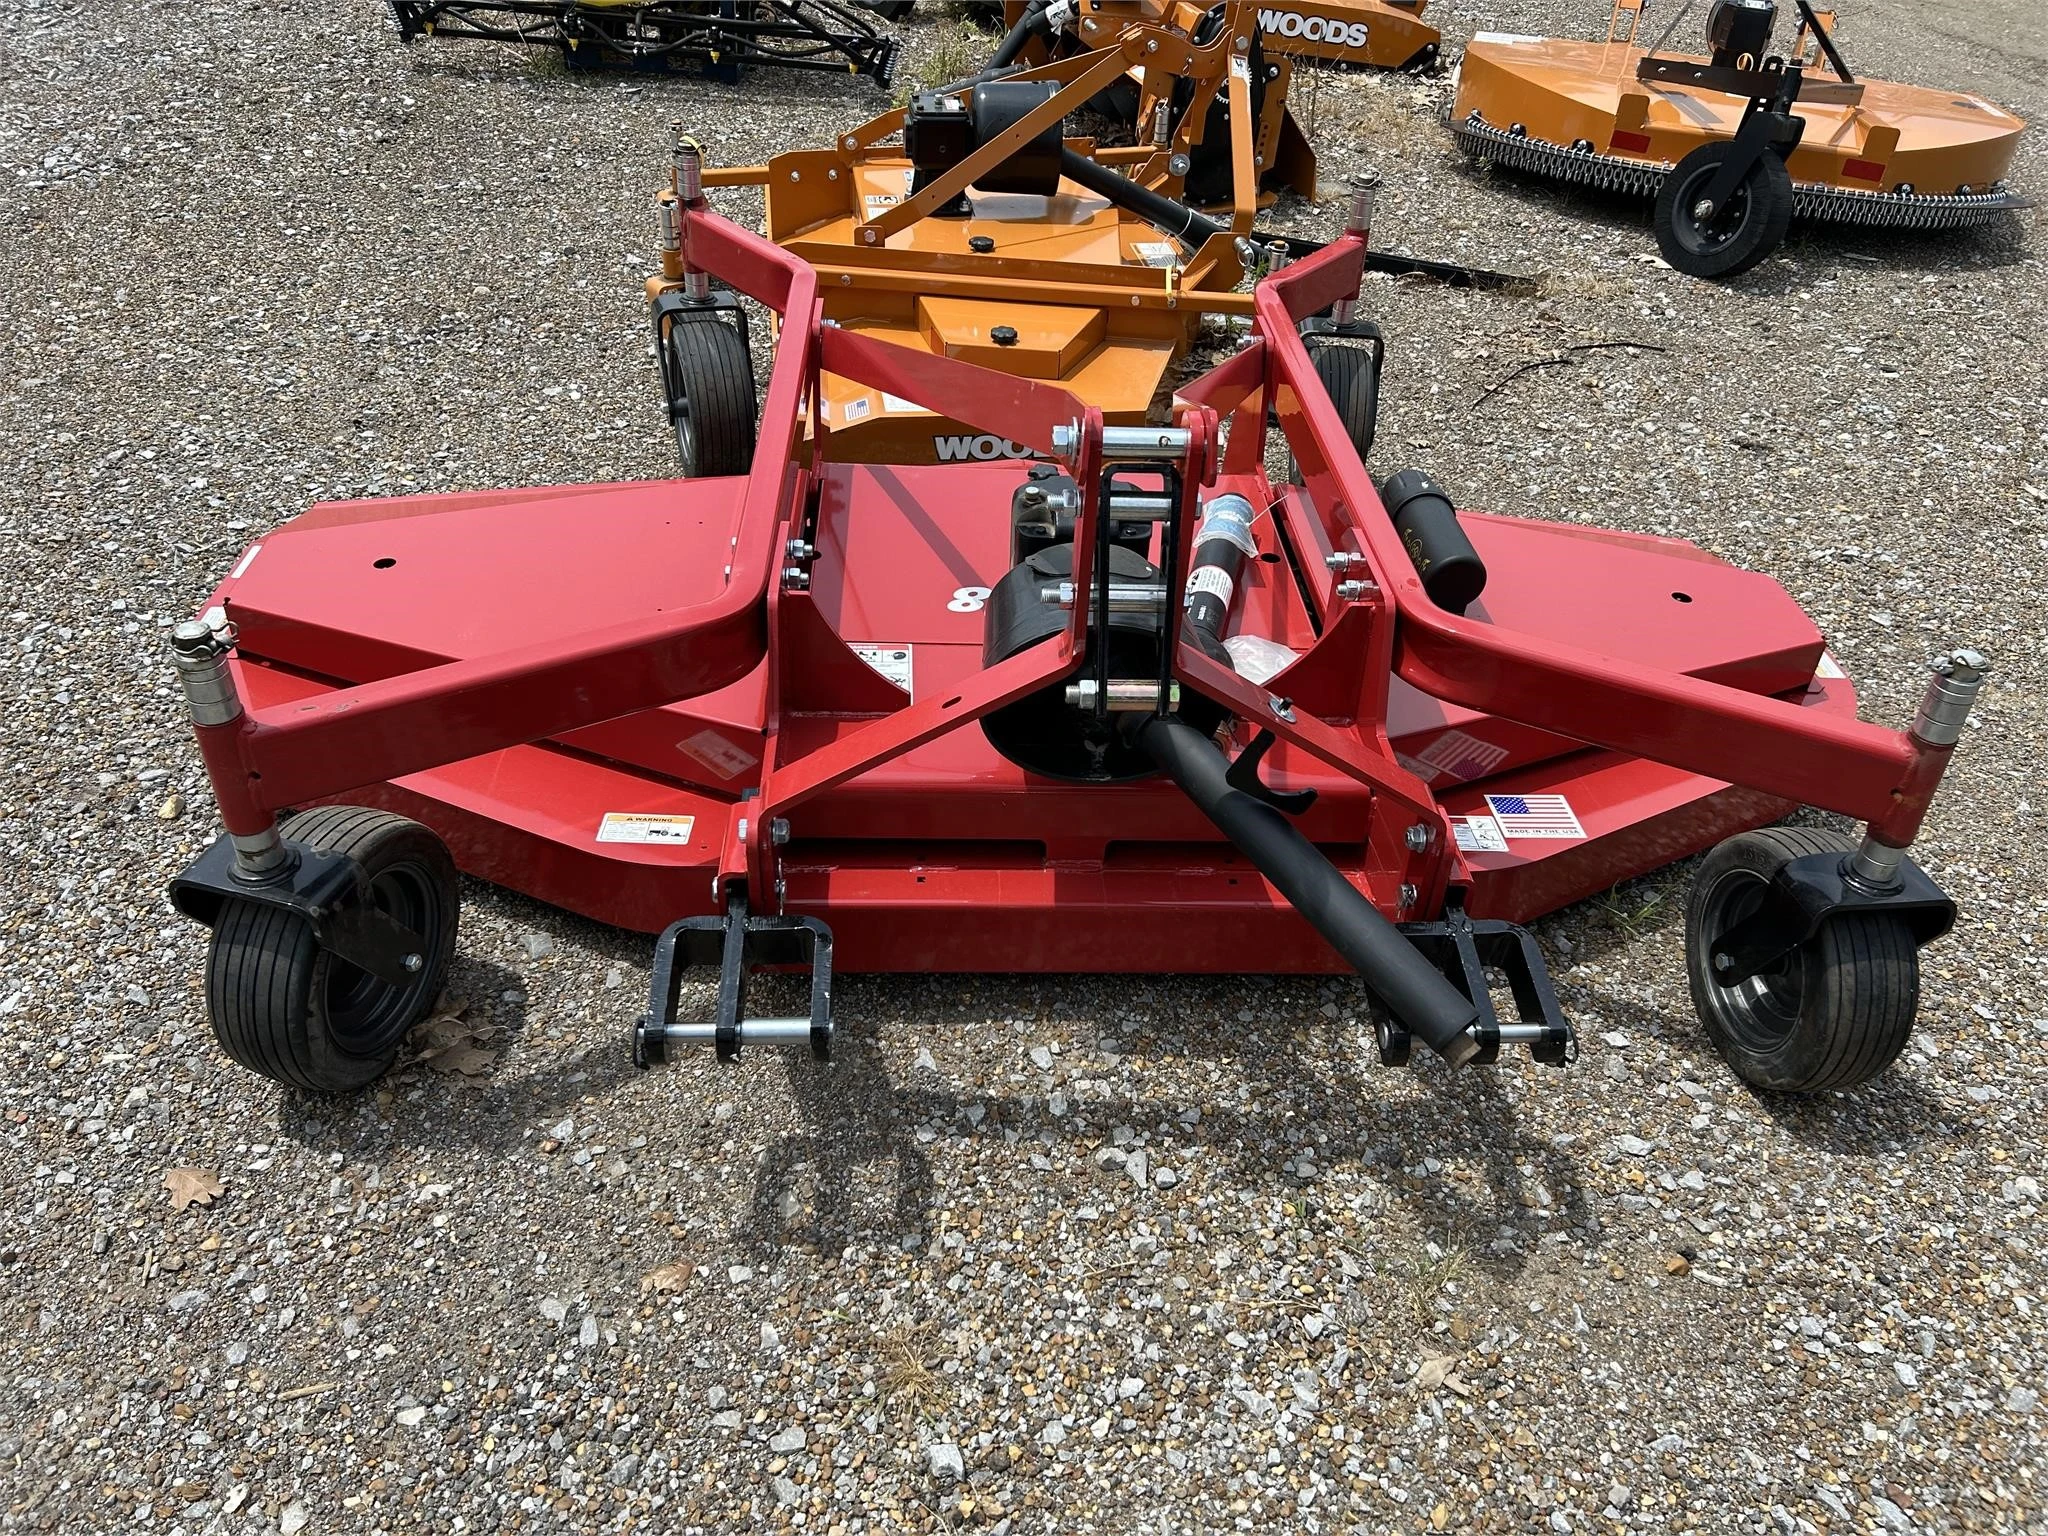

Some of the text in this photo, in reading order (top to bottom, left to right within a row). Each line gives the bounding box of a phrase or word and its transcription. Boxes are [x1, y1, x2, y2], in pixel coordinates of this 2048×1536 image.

[1257, 8, 1369, 47] WOODS
[934, 434, 1053, 460] WOO
[946, 586, 993, 613] 8
